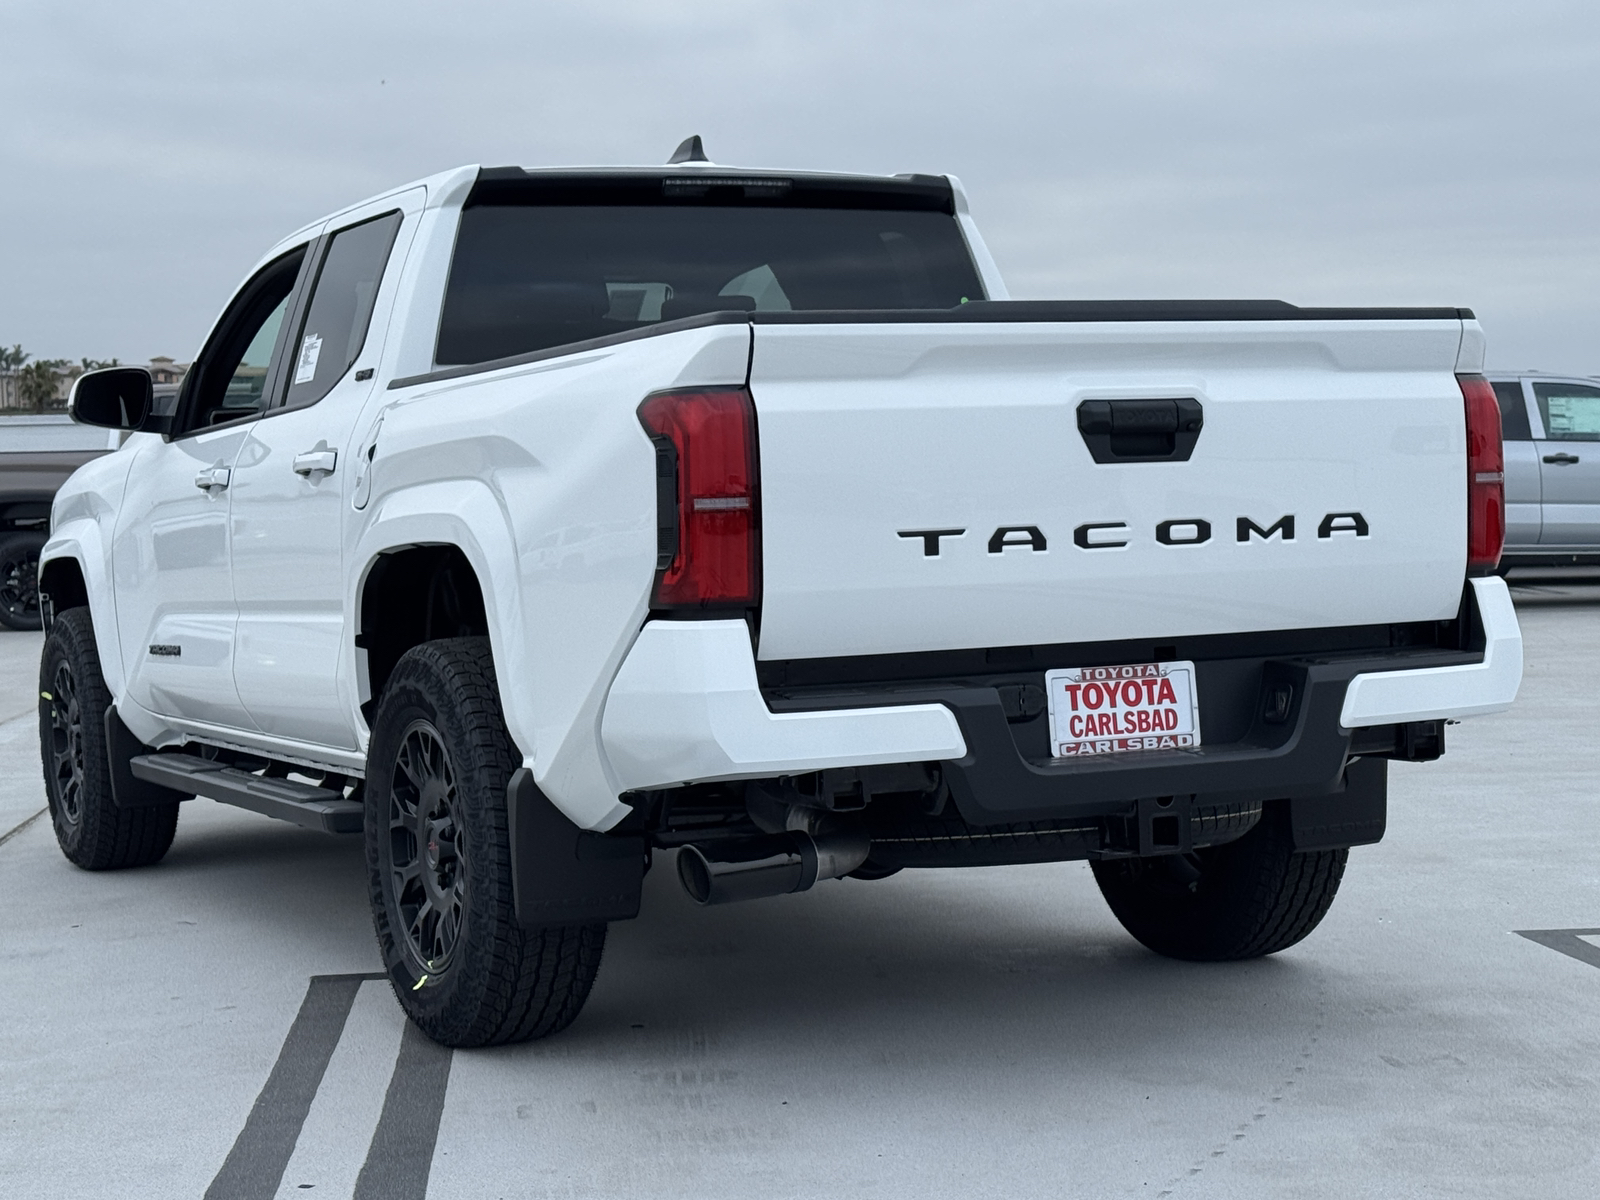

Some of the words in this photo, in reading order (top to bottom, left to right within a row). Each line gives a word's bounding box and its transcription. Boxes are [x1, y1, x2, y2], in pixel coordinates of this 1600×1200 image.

[1115, 410, 1175, 423] TOYOTA
[896, 512, 1370, 556] TACOMA
[1083, 665, 1158, 680] TOYOTA
[1065, 678, 1177, 711] TOYOTA
[1069, 708, 1178, 738] CARLSBAD
[1060, 734, 1193, 756] CARLSBAD
